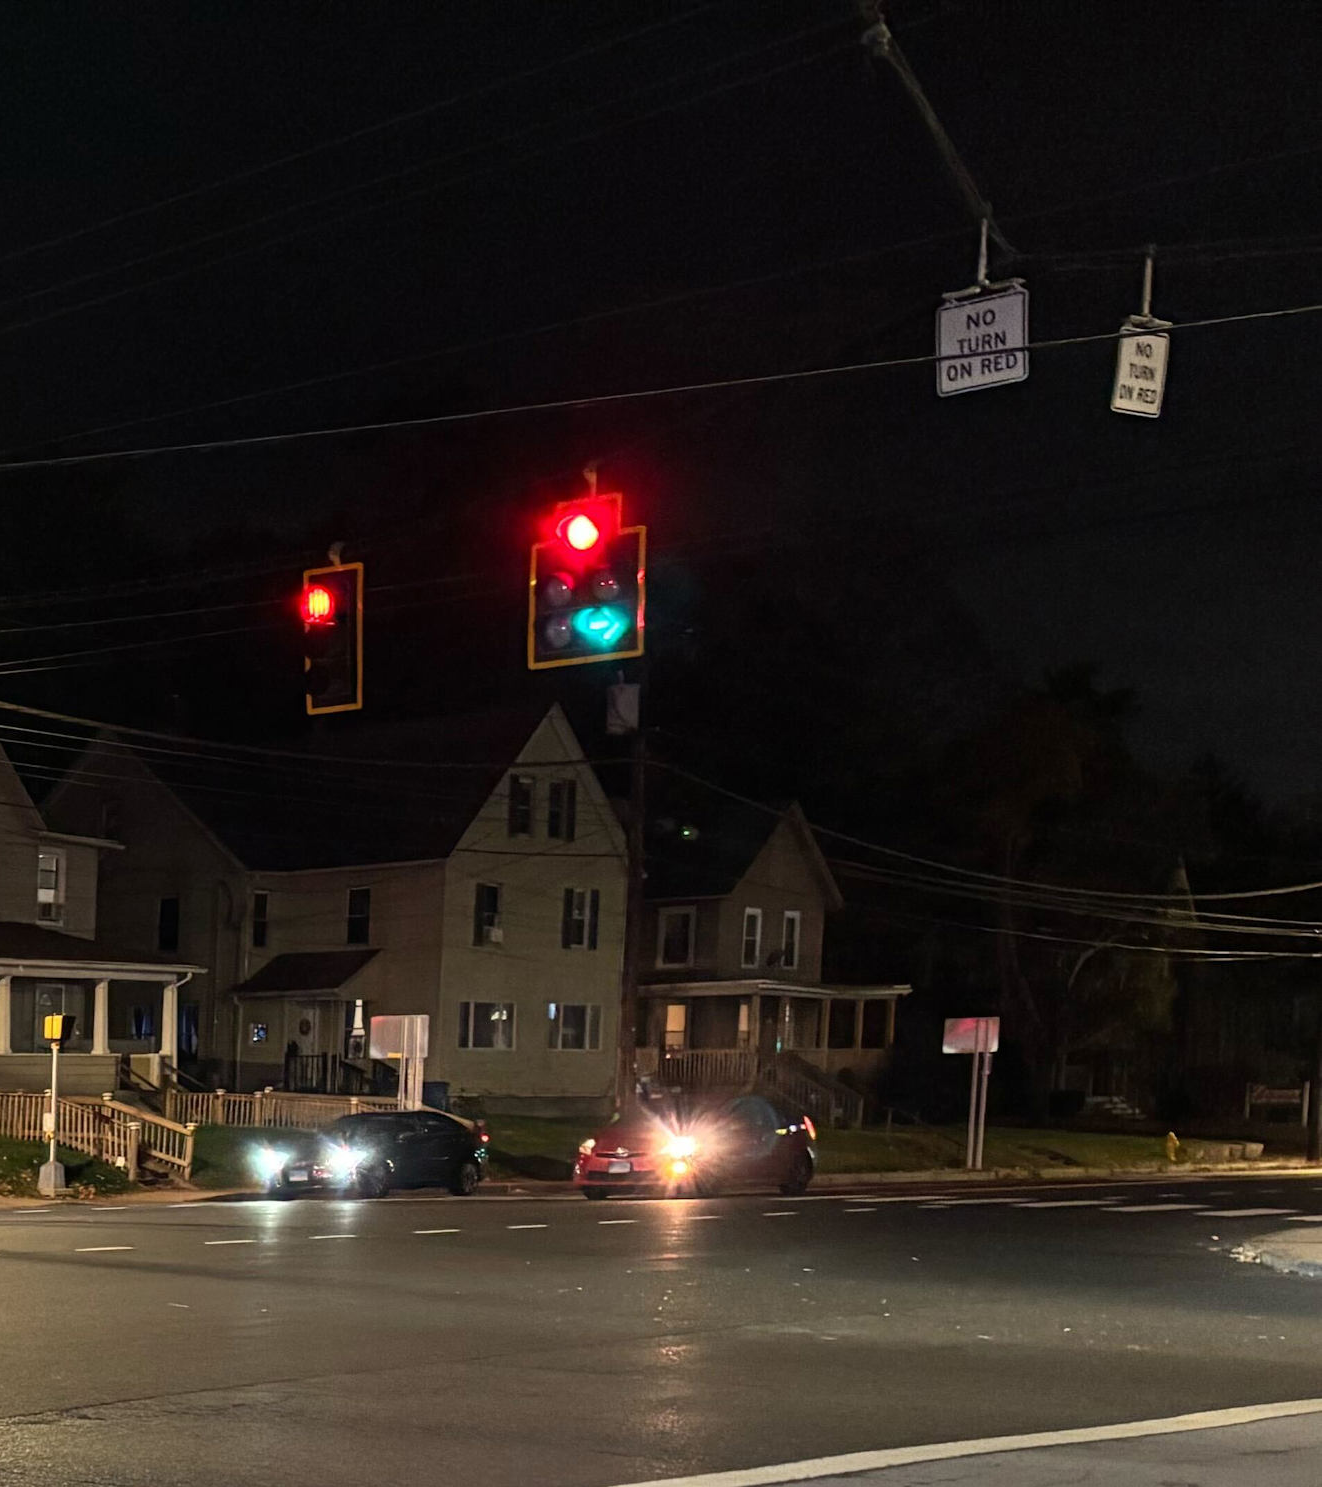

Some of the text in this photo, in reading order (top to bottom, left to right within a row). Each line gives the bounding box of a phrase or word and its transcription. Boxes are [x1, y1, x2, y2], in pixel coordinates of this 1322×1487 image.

[966, 309, 996, 330] NO
[957, 331, 1006, 354] TURN
[1136, 342, 1152, 358] NO
[946, 353, 1018, 382] ON RED
[1130, 363, 1155, 381] TURN
[1119, 384, 1157, 404] ON RED
